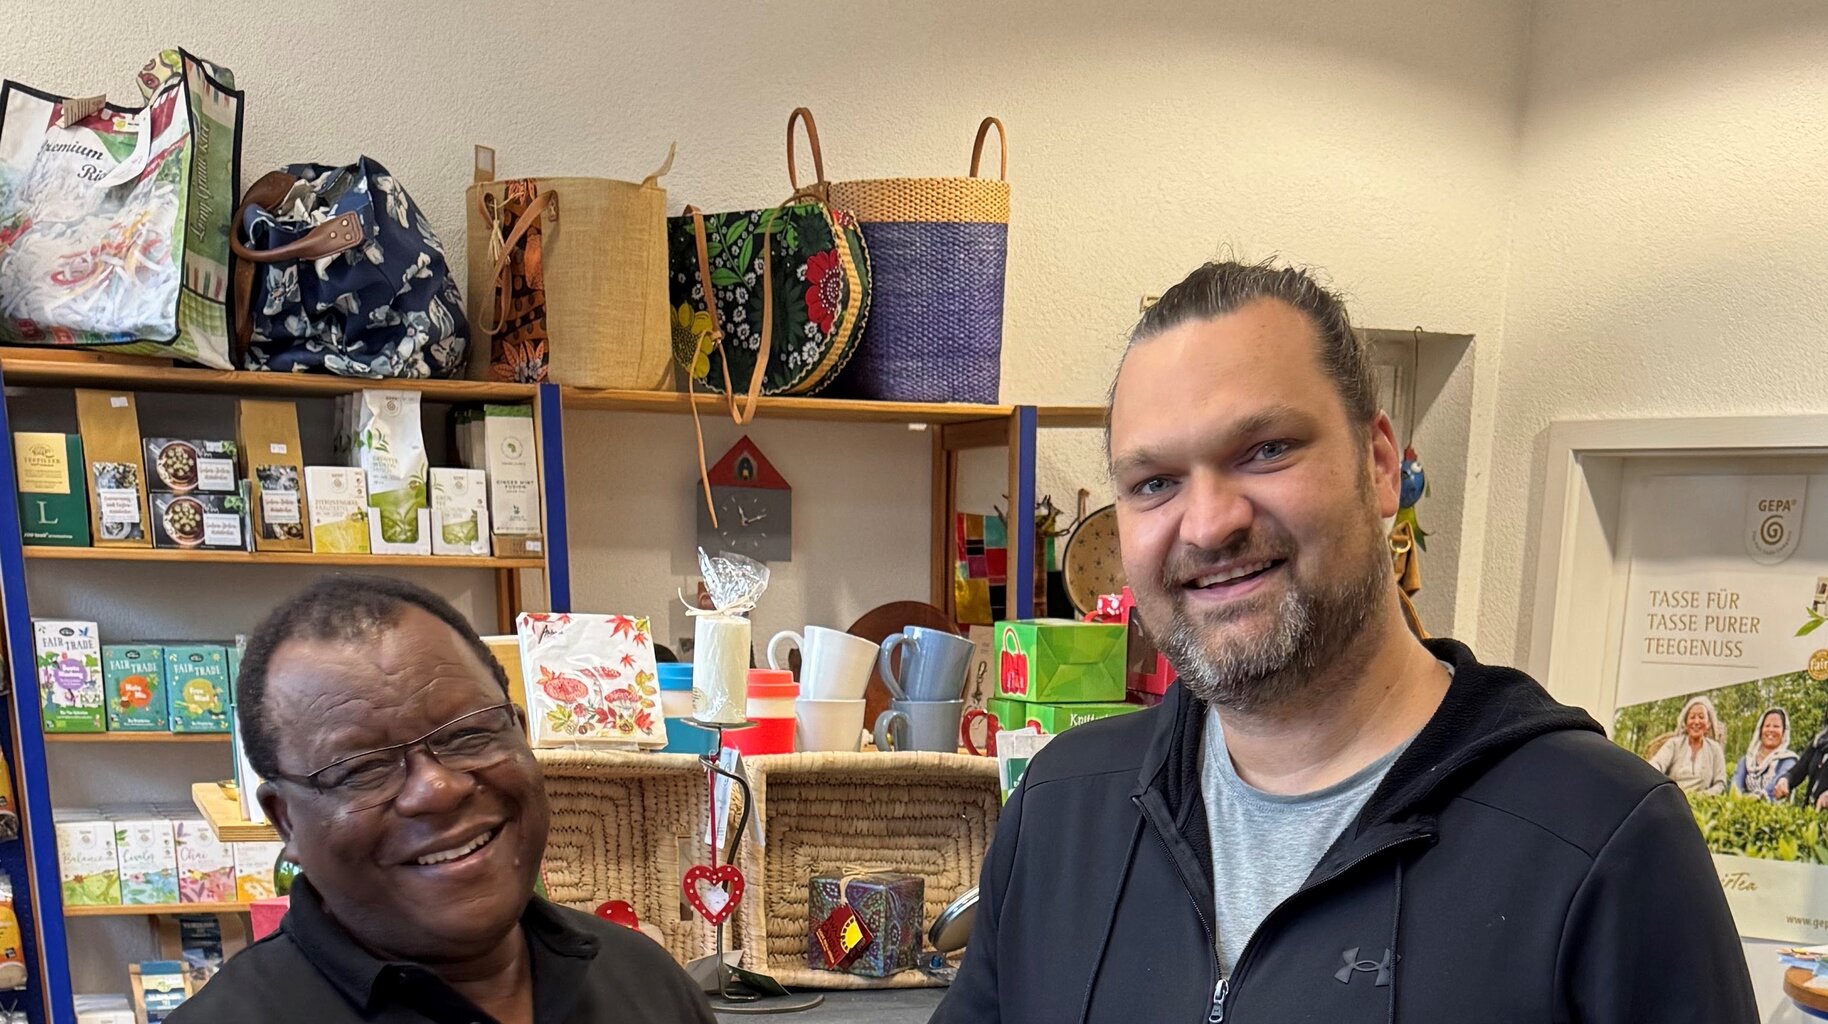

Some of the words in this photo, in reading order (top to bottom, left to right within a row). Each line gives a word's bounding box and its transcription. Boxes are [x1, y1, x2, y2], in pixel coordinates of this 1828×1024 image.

[42, 139, 104, 160] remium
[36, 501, 58, 524] L
[1650, 590, 1700, 609] TASSE
[1706, 588, 1740, 610] FÜR
[1647, 613, 1698, 632] TASSE
[1704, 615, 1761, 634] PURER
[42, 637, 64, 648] FAIR
[65, 639, 94, 651] TRADE
[1644, 637, 1744, 658] TEEGENUSS
[109, 659, 131, 671] FAIR
[131, 662, 158, 673] TRADE
[173, 664, 194, 674] FAIR
[194, 665, 221, 676] TRADE
[1721, 871, 1758, 891] irTea
